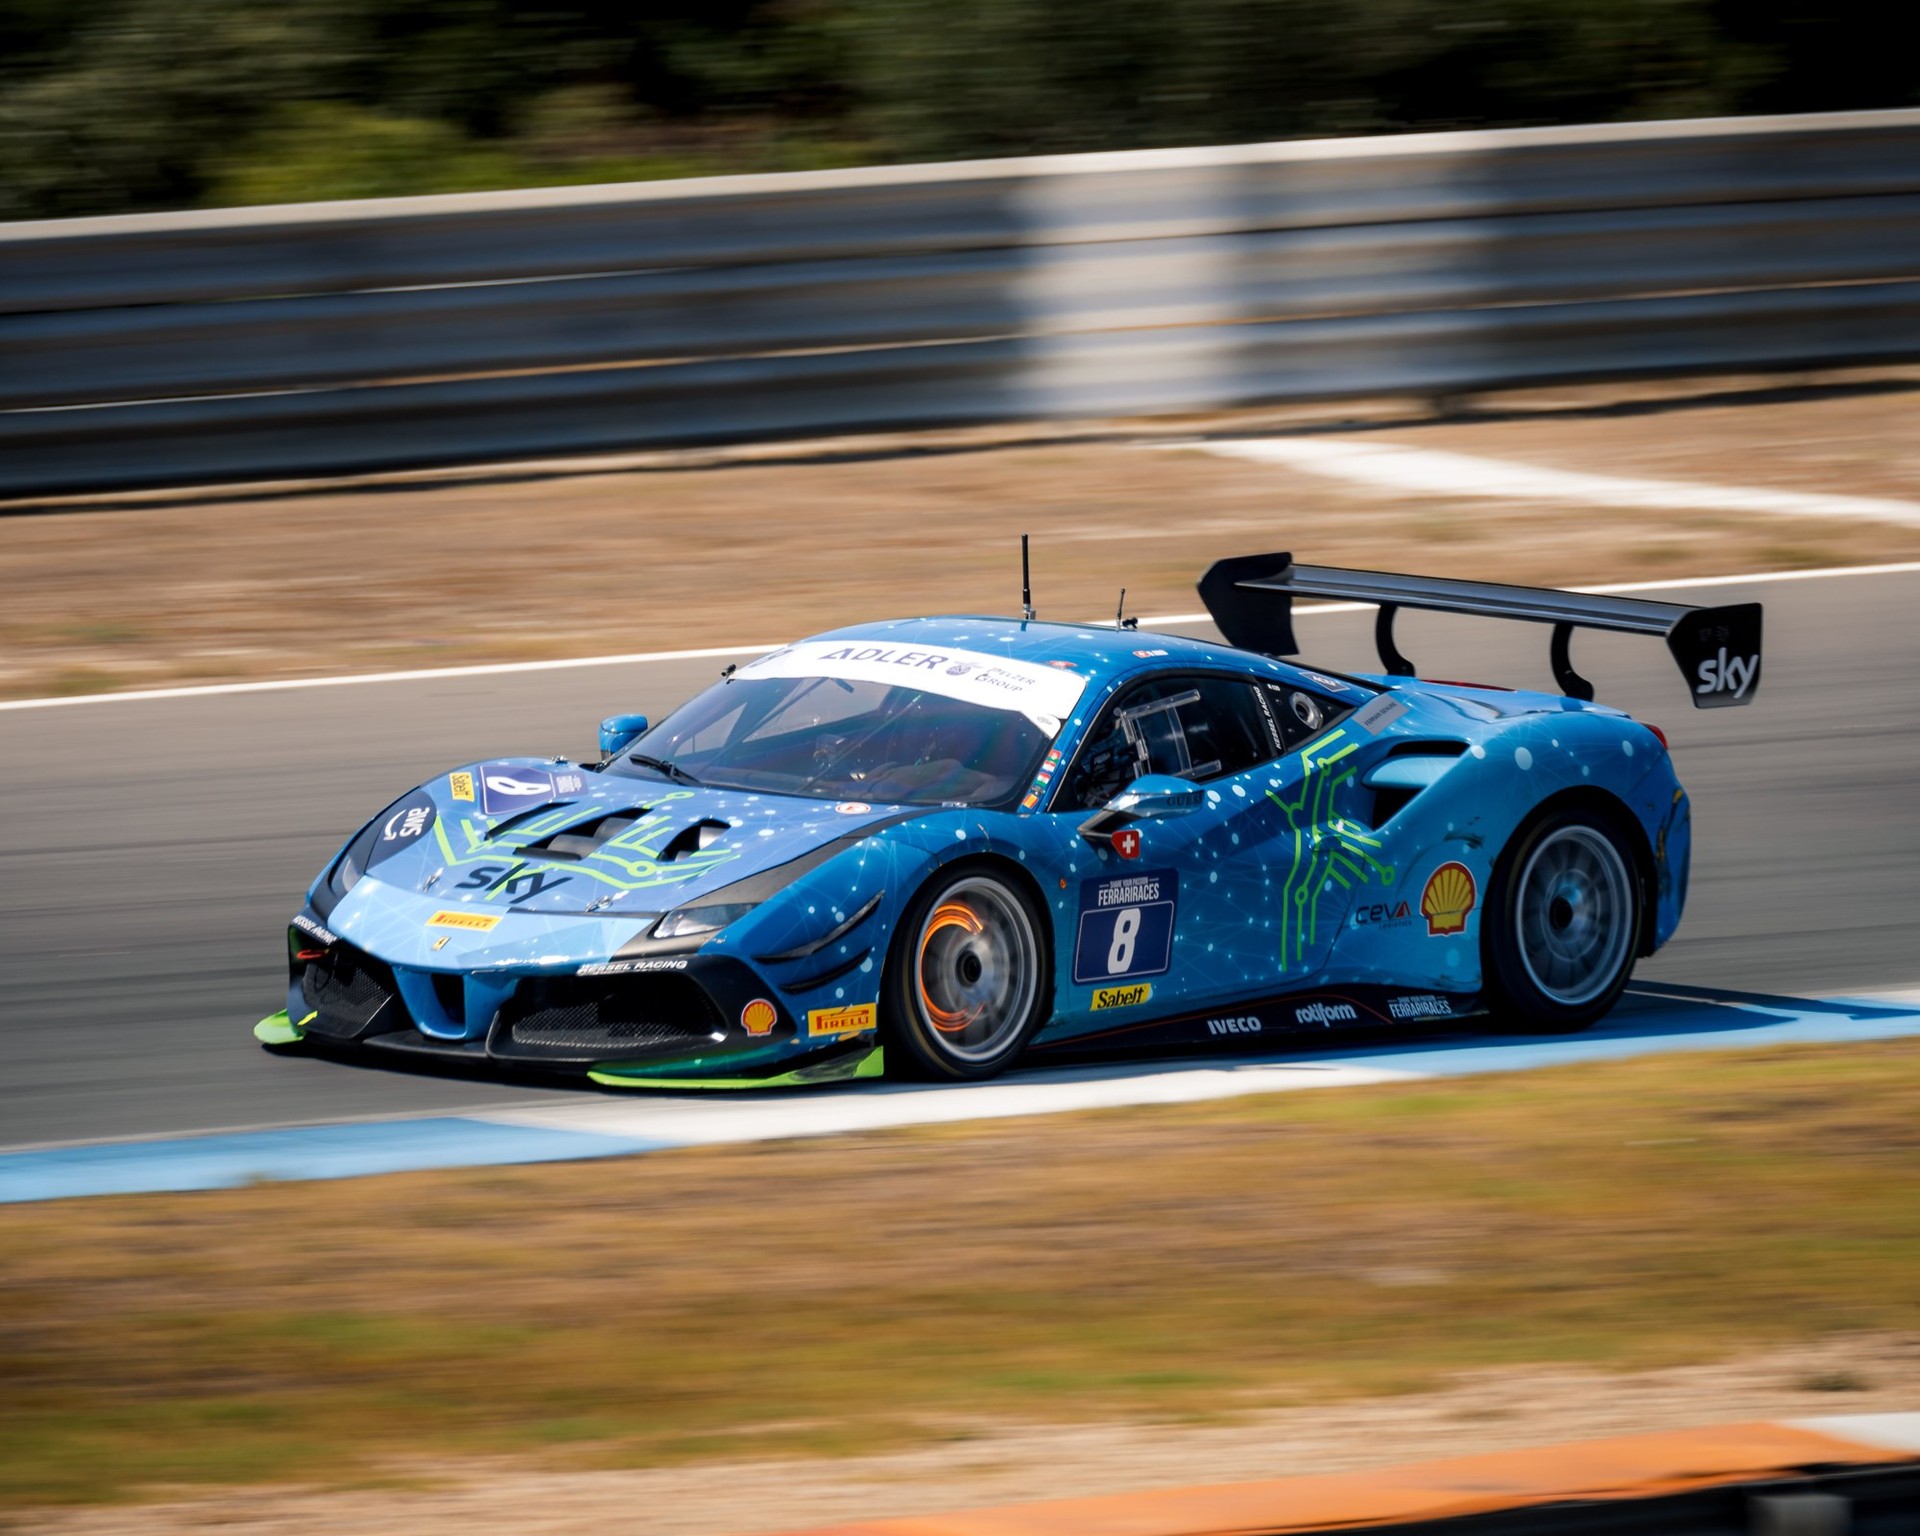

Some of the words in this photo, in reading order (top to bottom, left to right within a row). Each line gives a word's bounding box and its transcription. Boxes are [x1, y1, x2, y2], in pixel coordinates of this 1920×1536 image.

[818, 648, 949, 670] ADLER
[975, 674, 1022, 692] GROUP
[1696, 647, 1759, 699] sky
[1253, 686, 1270, 717] RACING
[1266, 717, 1282, 750] KESSEL
[486, 776, 551, 795] 8
[399, 807, 430, 837] aws
[455, 862, 574, 904] sky
[1098, 883, 1160, 907] FERRARIRACES
[434, 914, 493, 928] PIRELLI
[1107, 907, 1142, 975] 8
[634, 960, 689, 972] RACING
[1097, 986, 1145, 1010] Sabelt
[1388, 1000, 1452, 1018] FERRARIRACES
[816, 1009, 869, 1031] PIRELLI
[1207, 1016, 1262, 1035] IVECO
[1295, 1002, 1358, 1028] rotiform
